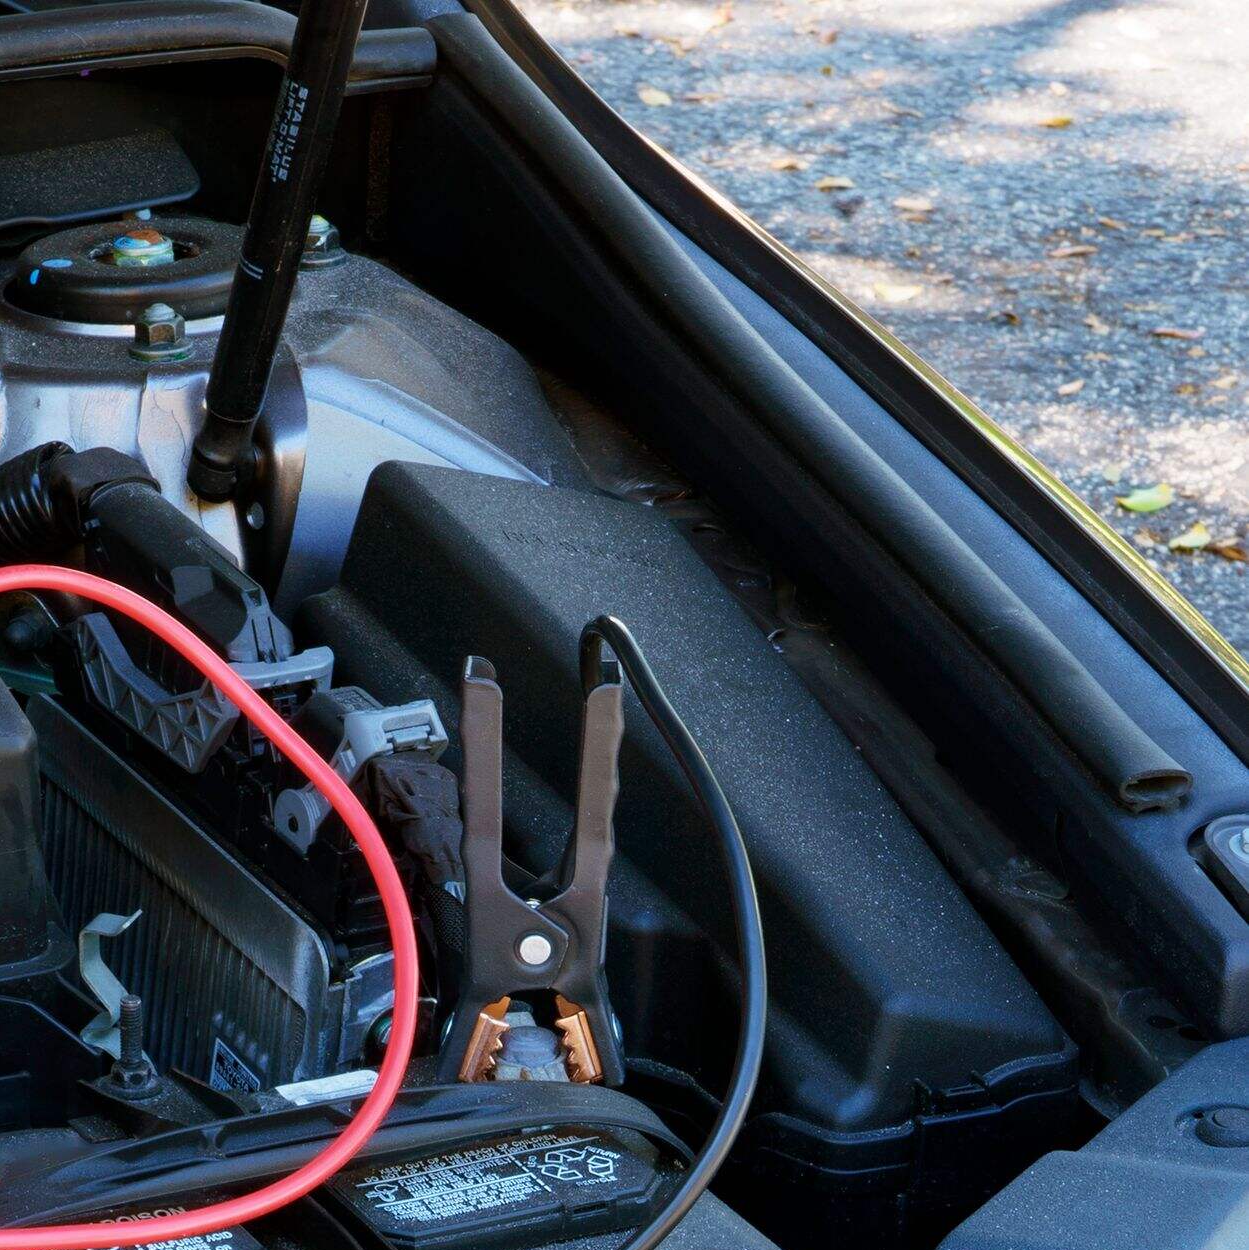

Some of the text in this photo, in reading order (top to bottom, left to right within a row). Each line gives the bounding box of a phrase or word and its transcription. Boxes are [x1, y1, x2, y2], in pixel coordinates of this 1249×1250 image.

[277, 86, 309, 181] STABILUS
[364, 1175, 379, 1183] DO
[381, 1172, 399, 1180] NOT
[503, 1145, 531, 1156] TIGHT
[553, 1135, 582, 1145] LEVEL
[405, 1160, 425, 1169] OUT
[427, 1157, 439, 1165] OF
[442, 1152, 462, 1162] THE
[464, 1147, 495, 1158] REACH
[496, 1142, 509, 1150] OF
[511, 1134, 557, 1147] CHILDREN
[584, 1145, 622, 1159] RETURN
[398, 1157, 512, 1187] FLUSH EYES IMMEDIATELY
[404, 1183, 430, 1192] WITH
[464, 1170, 483, 1179] GET
[576, 1175, 618, 1187] RECYCLE
[411, 1185, 451, 1199] MEDICAL
[451, 1179, 474, 1189] HELP
[490, 1176, 532, 1190] STARTING
[146, 1231, 233, 1250] SULFURIC ACID
